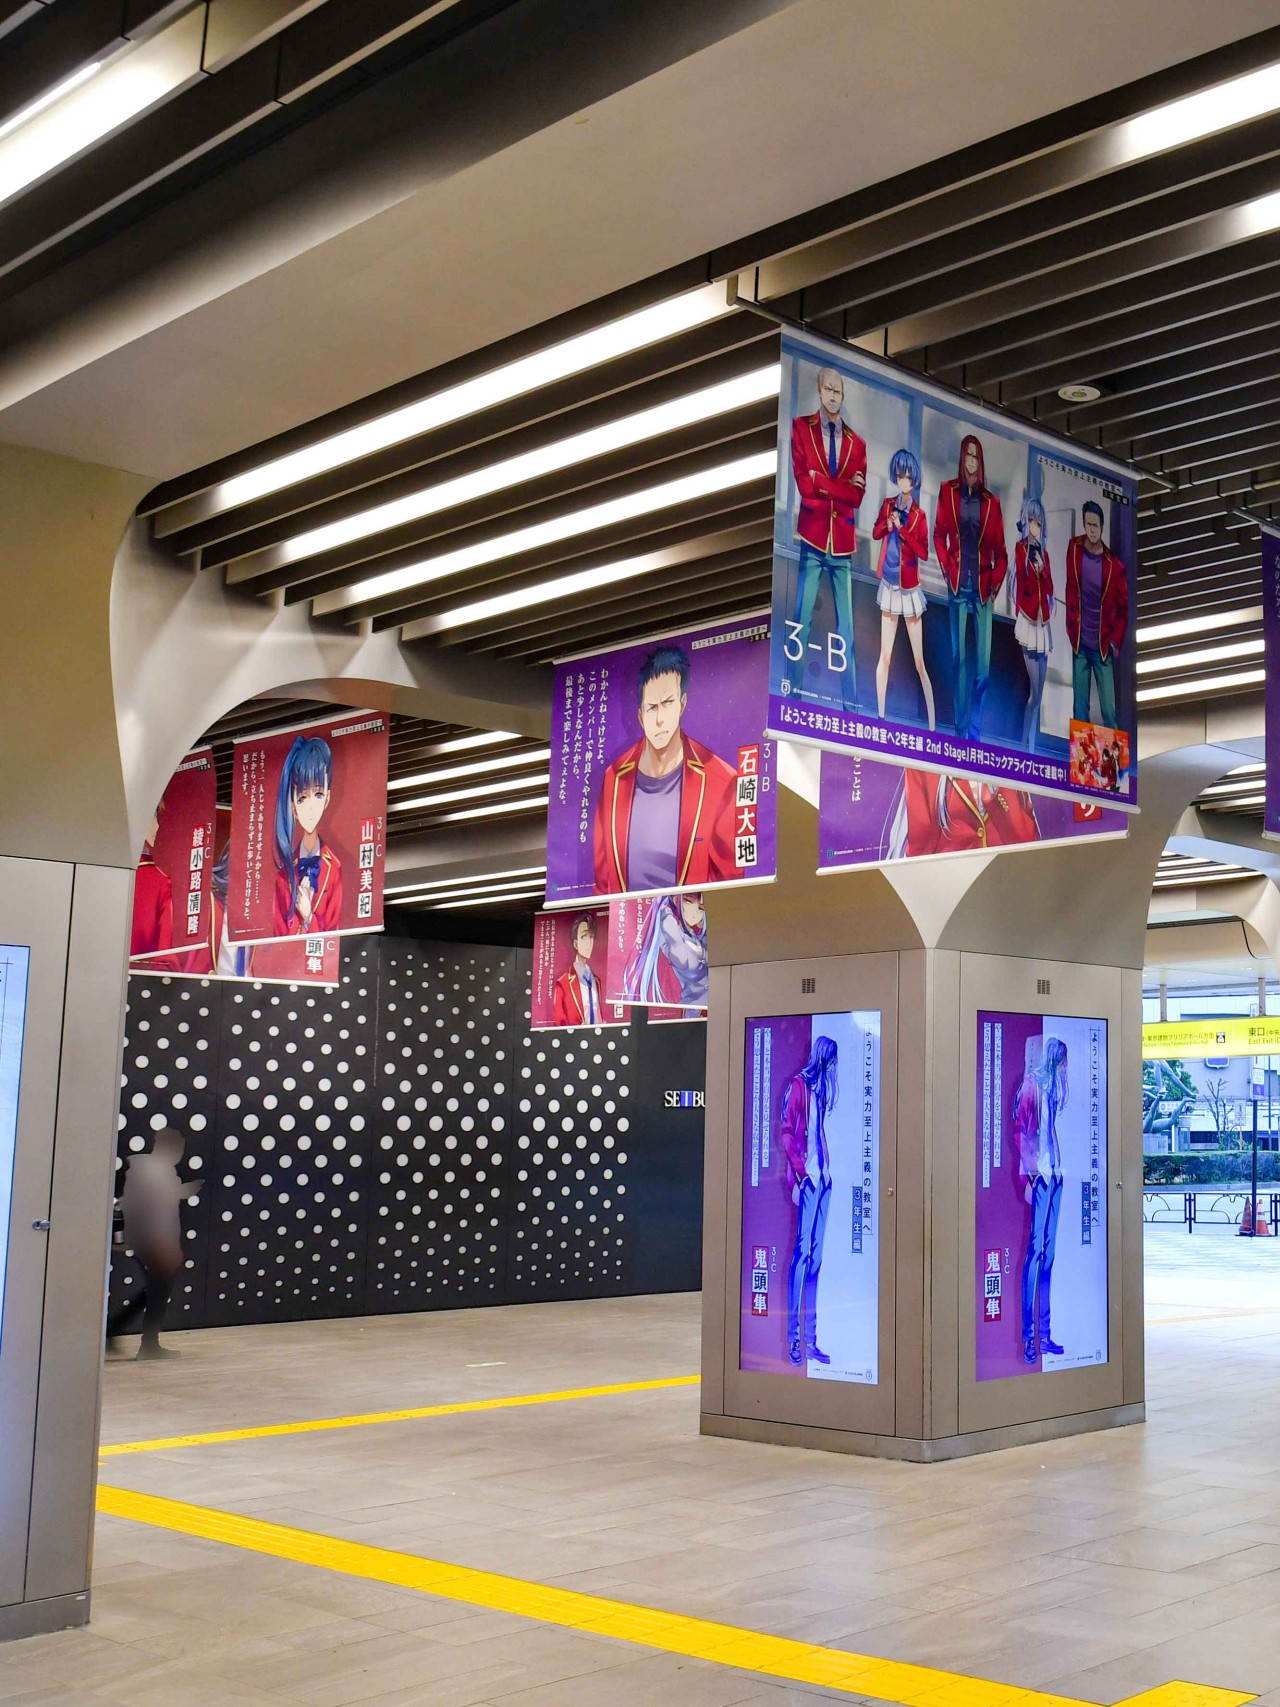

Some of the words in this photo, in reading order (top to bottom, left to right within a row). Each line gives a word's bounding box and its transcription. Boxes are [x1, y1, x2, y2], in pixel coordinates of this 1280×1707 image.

[783, 620, 848, 673] 3-B
[573, 673, 585, 780] あと少しなんだから、
[579, 671, 597, 843] このメンバーで仲良くやれるのも
[926, 738, 942, 755] 2nd
[737, 747, 757, 863] 石崎大地
[188, 828, 204, 935] 綾小路清隆
[358, 820, 373, 917] 山村美紀
[863, 1028, 873, 1232] ようこそ実力至上主義の教室へ
[1090, 1032, 1099, 1225] ようこそ実力至上主義の教室へ
[753, 1248, 767, 1313] 鬼頭隼
[985, 1252, 1000, 1318] 鬼頭隼
